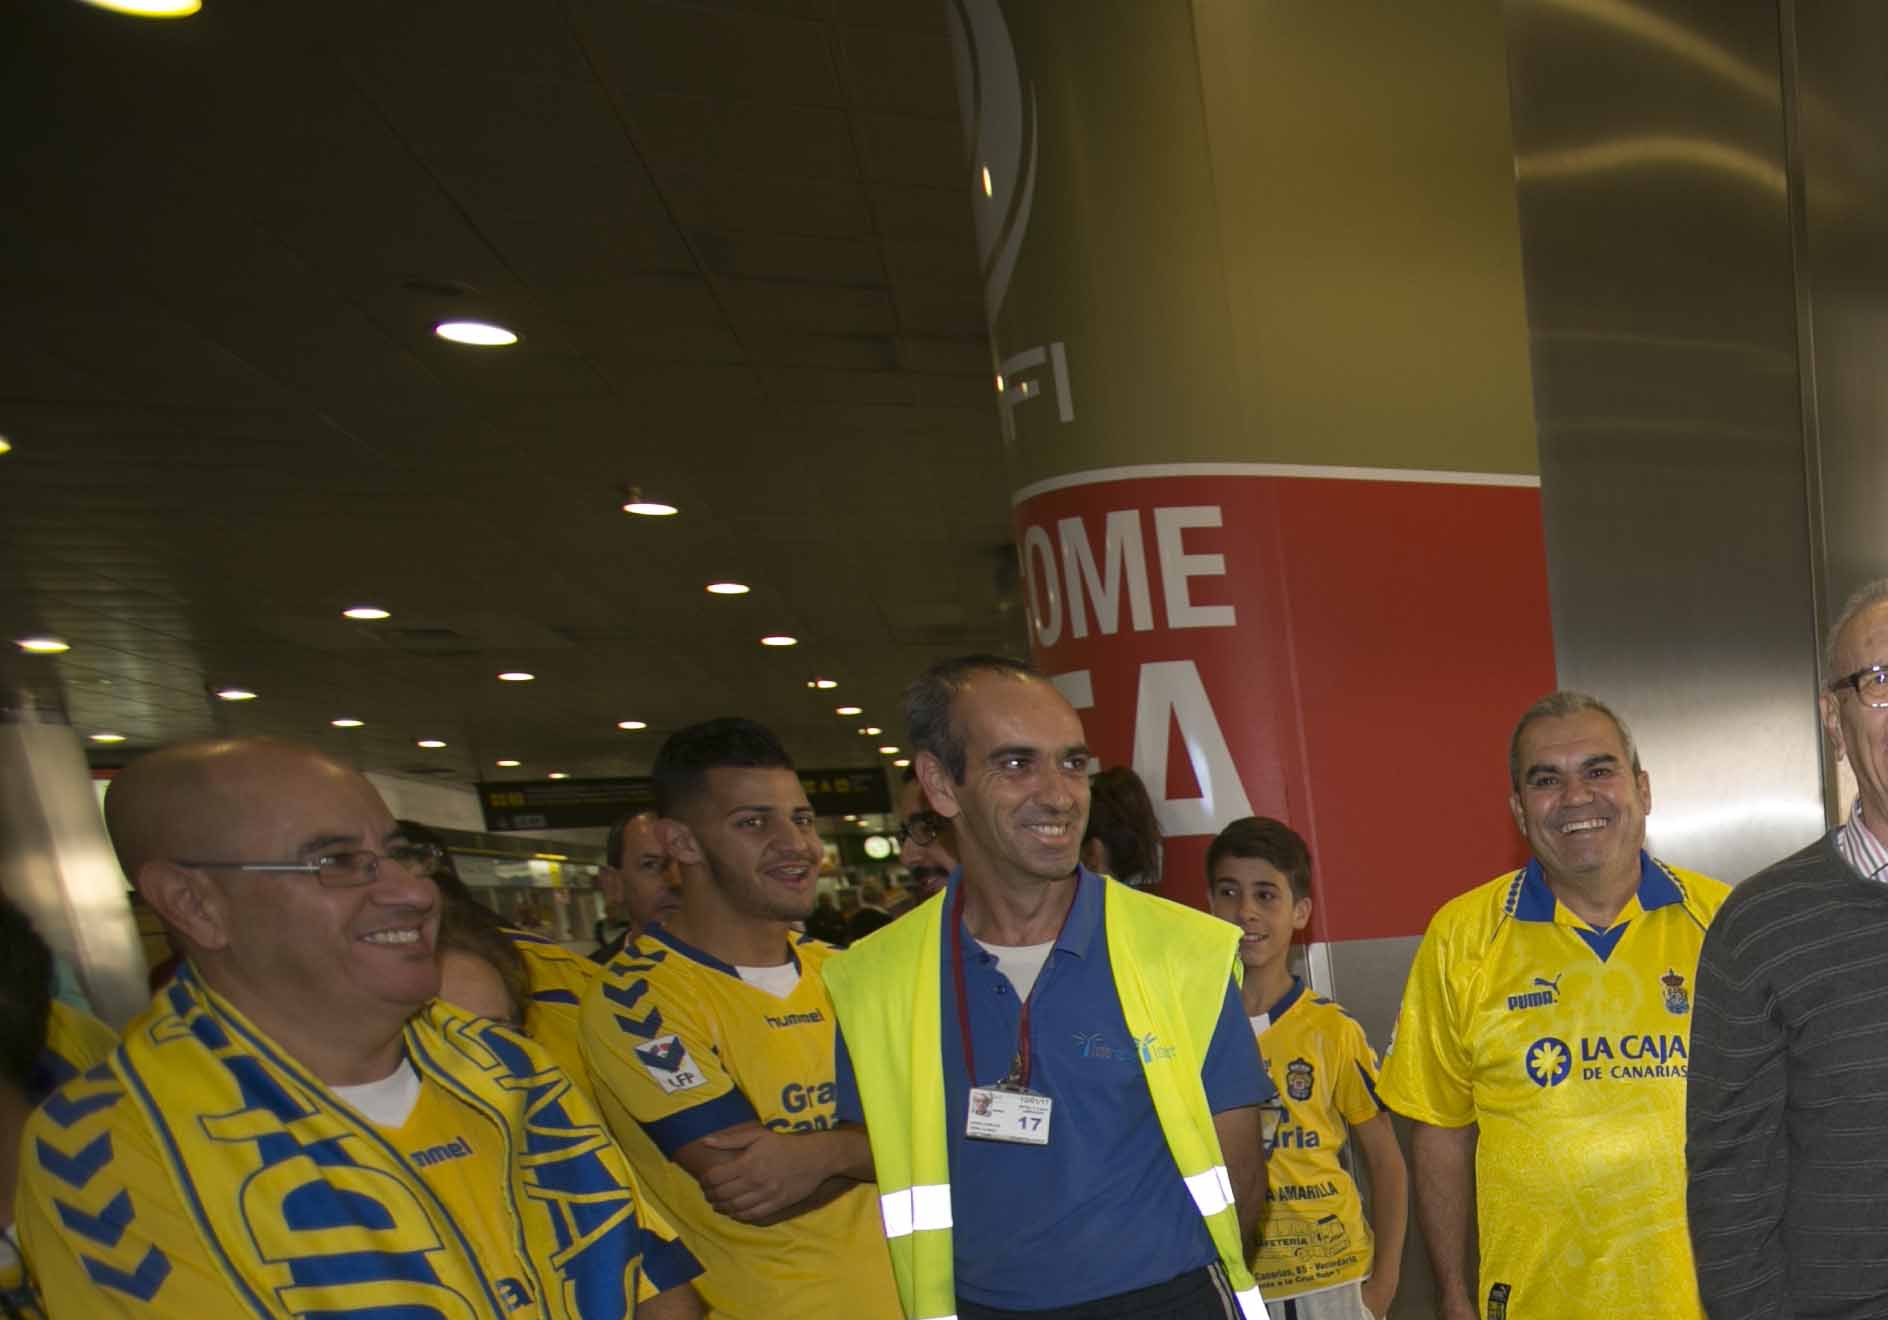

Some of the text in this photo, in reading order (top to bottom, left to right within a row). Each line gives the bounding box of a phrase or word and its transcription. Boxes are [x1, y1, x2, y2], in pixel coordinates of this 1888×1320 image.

[765, 1009, 825, 1028] hummel
[1581, 1035, 1687, 1064] LA CAJA
[1583, 1065, 1687, 1080] DE CANARIAS
[1018, 1116, 1042, 1131] 17
[1279, 1181, 1338, 1201] AMARILLA
